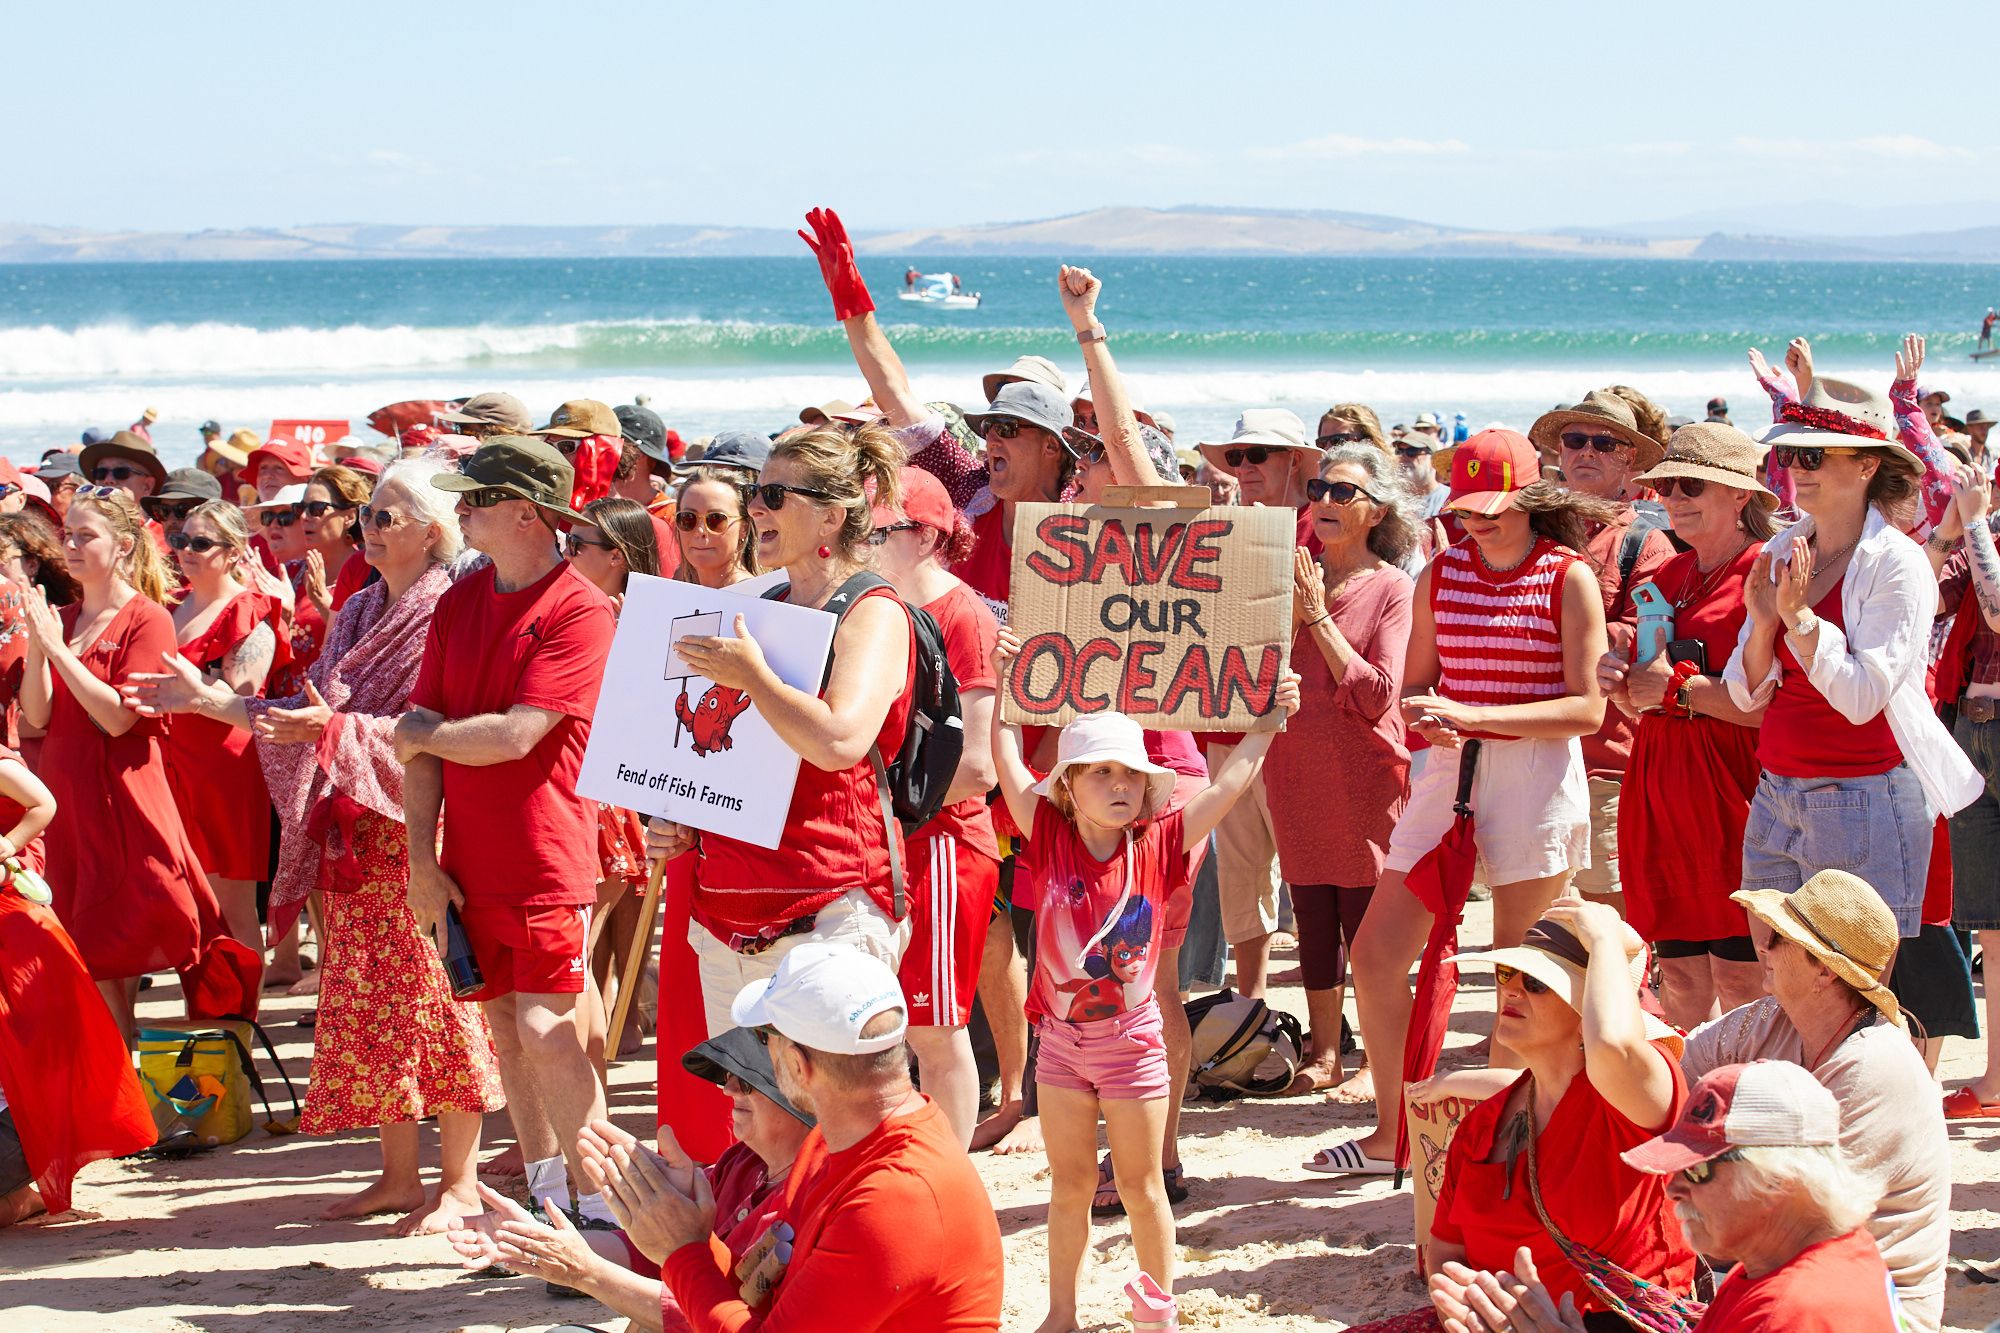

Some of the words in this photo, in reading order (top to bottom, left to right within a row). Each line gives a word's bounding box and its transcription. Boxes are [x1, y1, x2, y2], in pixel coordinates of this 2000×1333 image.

[294, 424, 326, 444] NO
[1025, 514, 1234, 593] SAVE
[1100, 593, 1207, 638] OUR
[1008, 631, 1283, 719] OCEAN
[616, 763, 648, 786] Fend
[648, 773, 669, 791] off
[668, 777, 697, 800] Fish
[699, 785, 743, 812] Farms
